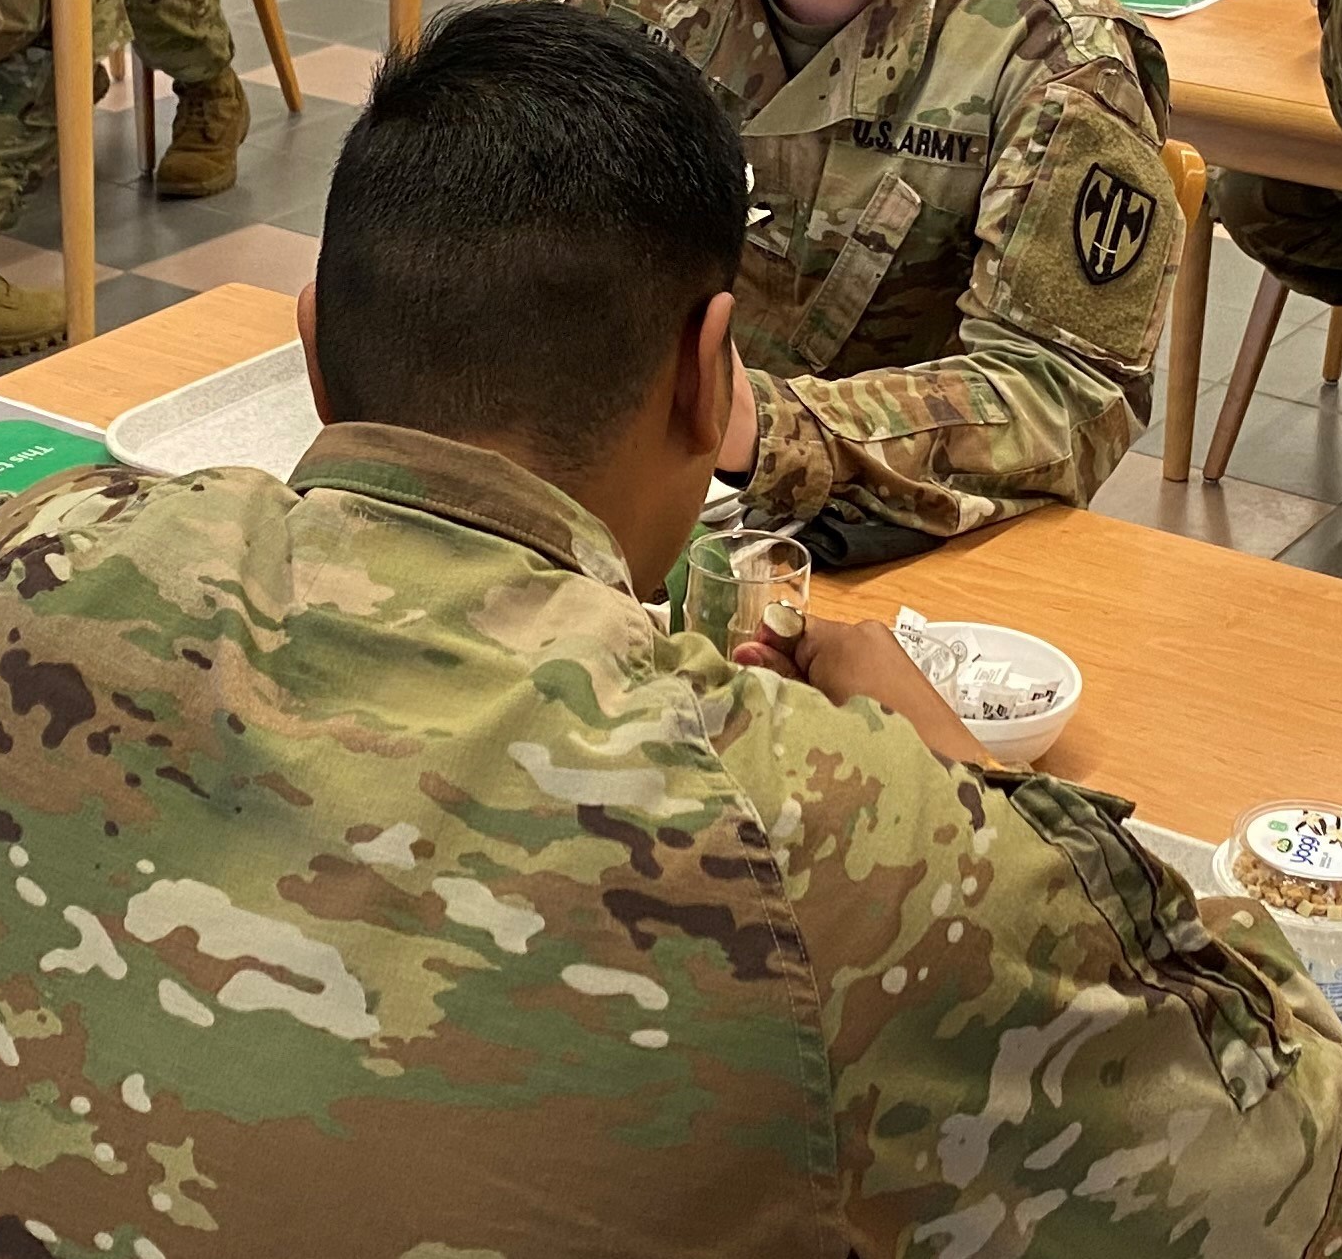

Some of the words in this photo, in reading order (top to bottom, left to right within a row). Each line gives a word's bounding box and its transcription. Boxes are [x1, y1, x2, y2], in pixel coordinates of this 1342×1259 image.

[853, 119, 894, 149] U.S.
[898, 125, 973, 162] ARMY
[9, 444, 55, 465] This
